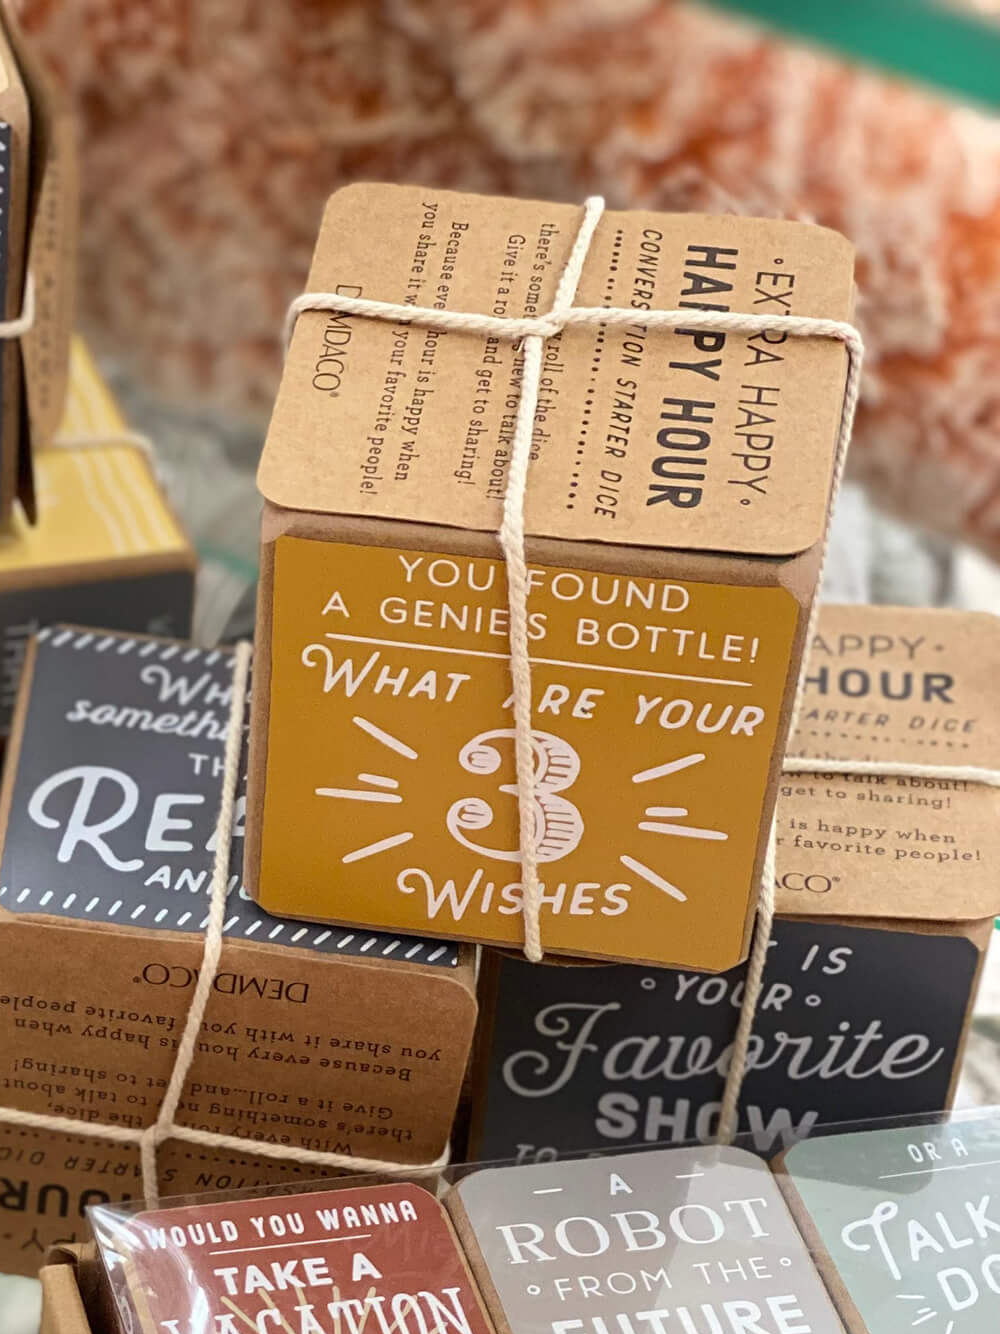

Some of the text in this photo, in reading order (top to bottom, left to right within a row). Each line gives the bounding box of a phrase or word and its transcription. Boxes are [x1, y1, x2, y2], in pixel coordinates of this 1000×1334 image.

[504, 234, 526, 266] Give
[533, 224, 560, 271] there's
[359, 201, 438, 495] you share your favorite people!
[395, 221, 469, 481] Because hour happy when
[454, 370, 493, 486] get sharing!
[594, 377, 637, 519] STARTER DICE
[728, 384, 780, 494] HAPPY
[646, 397, 716, 508] HOUR
[398, 555, 689, 613] YOU FOUND
[321, 591, 760, 664] A BOTTLE!
[300, 643, 765, 737] WHAT YOUR
[803, 667, 955, 703] HOUR
[909, 716, 977, 733] DICE
[780, 785, 952, 810] get sharing!
[793, 835, 981, 862] favorite people!
[818, 819, 956, 844] happy when
[396, 867, 632, 921] WISHES
[801, 943, 853, 975] IS
[85, 1000, 176, 1031] favorite
[673, 974, 794, 1012] YOUR
[14, 1018, 412, 1081] Because every happy when
[330, 1036, 392, 1058] share
[502, 1002, 944, 1099] Favorite
[12, 1058, 395, 1119] Give sharing!
[73, 1083, 119, 1102] talk
[208, 1101, 329, 1130] something
[336, 1119, 414, 1144] there's
[906, 1142, 942, 1164] OR
[609, 1172, 634, 1197] A
[142, 1199, 419, 1251] WOULD YOU WANNA
[495, 1196, 771, 1265] ROBOT
[214, 1252, 382, 1296] TAKE A
[552, 1255, 774, 1301] FROM THE
